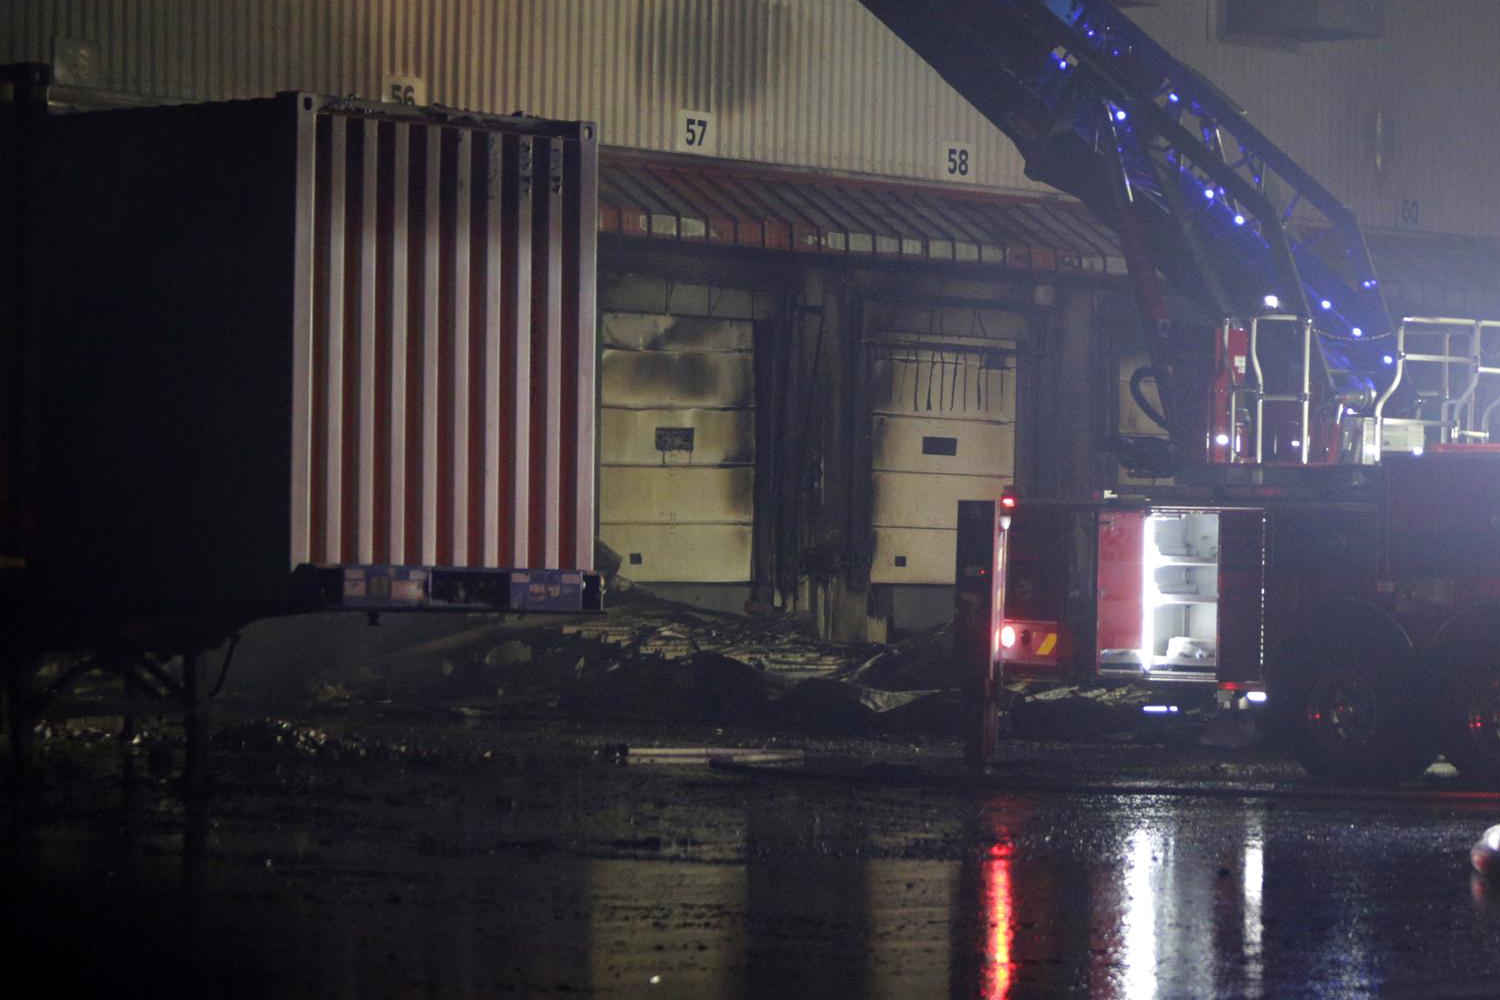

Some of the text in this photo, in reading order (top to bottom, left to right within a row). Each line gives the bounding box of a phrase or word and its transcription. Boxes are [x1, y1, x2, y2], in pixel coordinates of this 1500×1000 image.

[391, 84, 415, 107] 56
[686, 118, 708, 146] 57
[948, 148, 969, 176] 58
